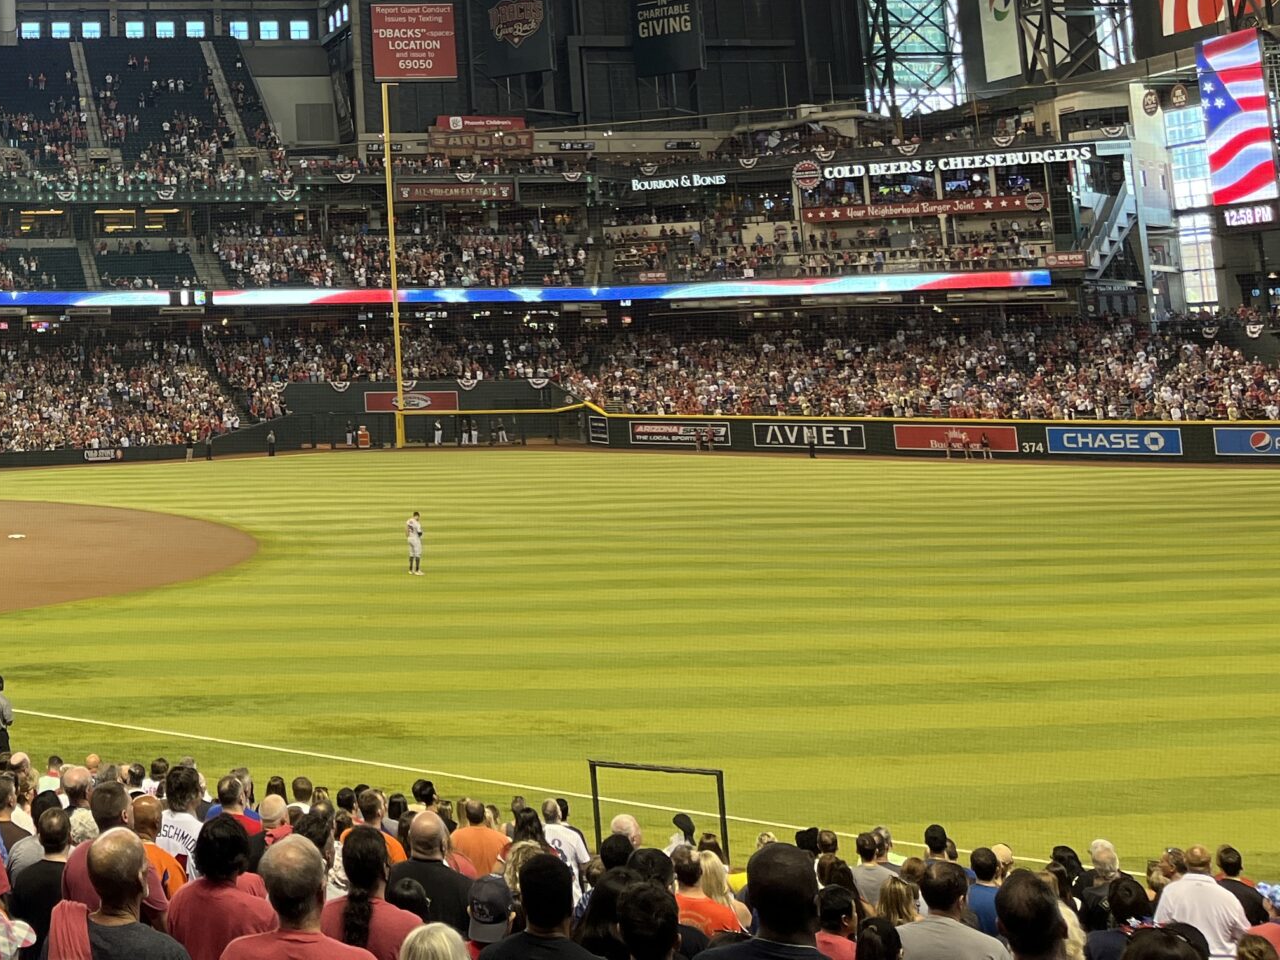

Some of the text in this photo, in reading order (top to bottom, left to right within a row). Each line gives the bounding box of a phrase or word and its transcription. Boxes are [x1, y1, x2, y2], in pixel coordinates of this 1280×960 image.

[375, 6, 398, 14] Report
[400, 6, 420, 14] Guest
[637, 3, 691, 21] CHARITABLE
[418, 15, 443, 23] Texting
[638, 16, 692, 38] GIVING
[388, 40, 440, 50] LOCATION
[398, 59, 433, 69] 69050
[823, 146, 1092, 179] COLD BEERS & CHEESEBURGERS
[631, 174, 727, 191] BOURBON & BONES
[847, 199, 975, 218] Your Neighborhood Burger Joint
[1224, 205, 1272, 226] 12:58 PM
[636, 425, 678, 433] ARIZONA
[766, 425, 852, 445] AVNET
[1022, 442, 1044, 453] 374
[1063, 433, 1140, 449] CHASE
